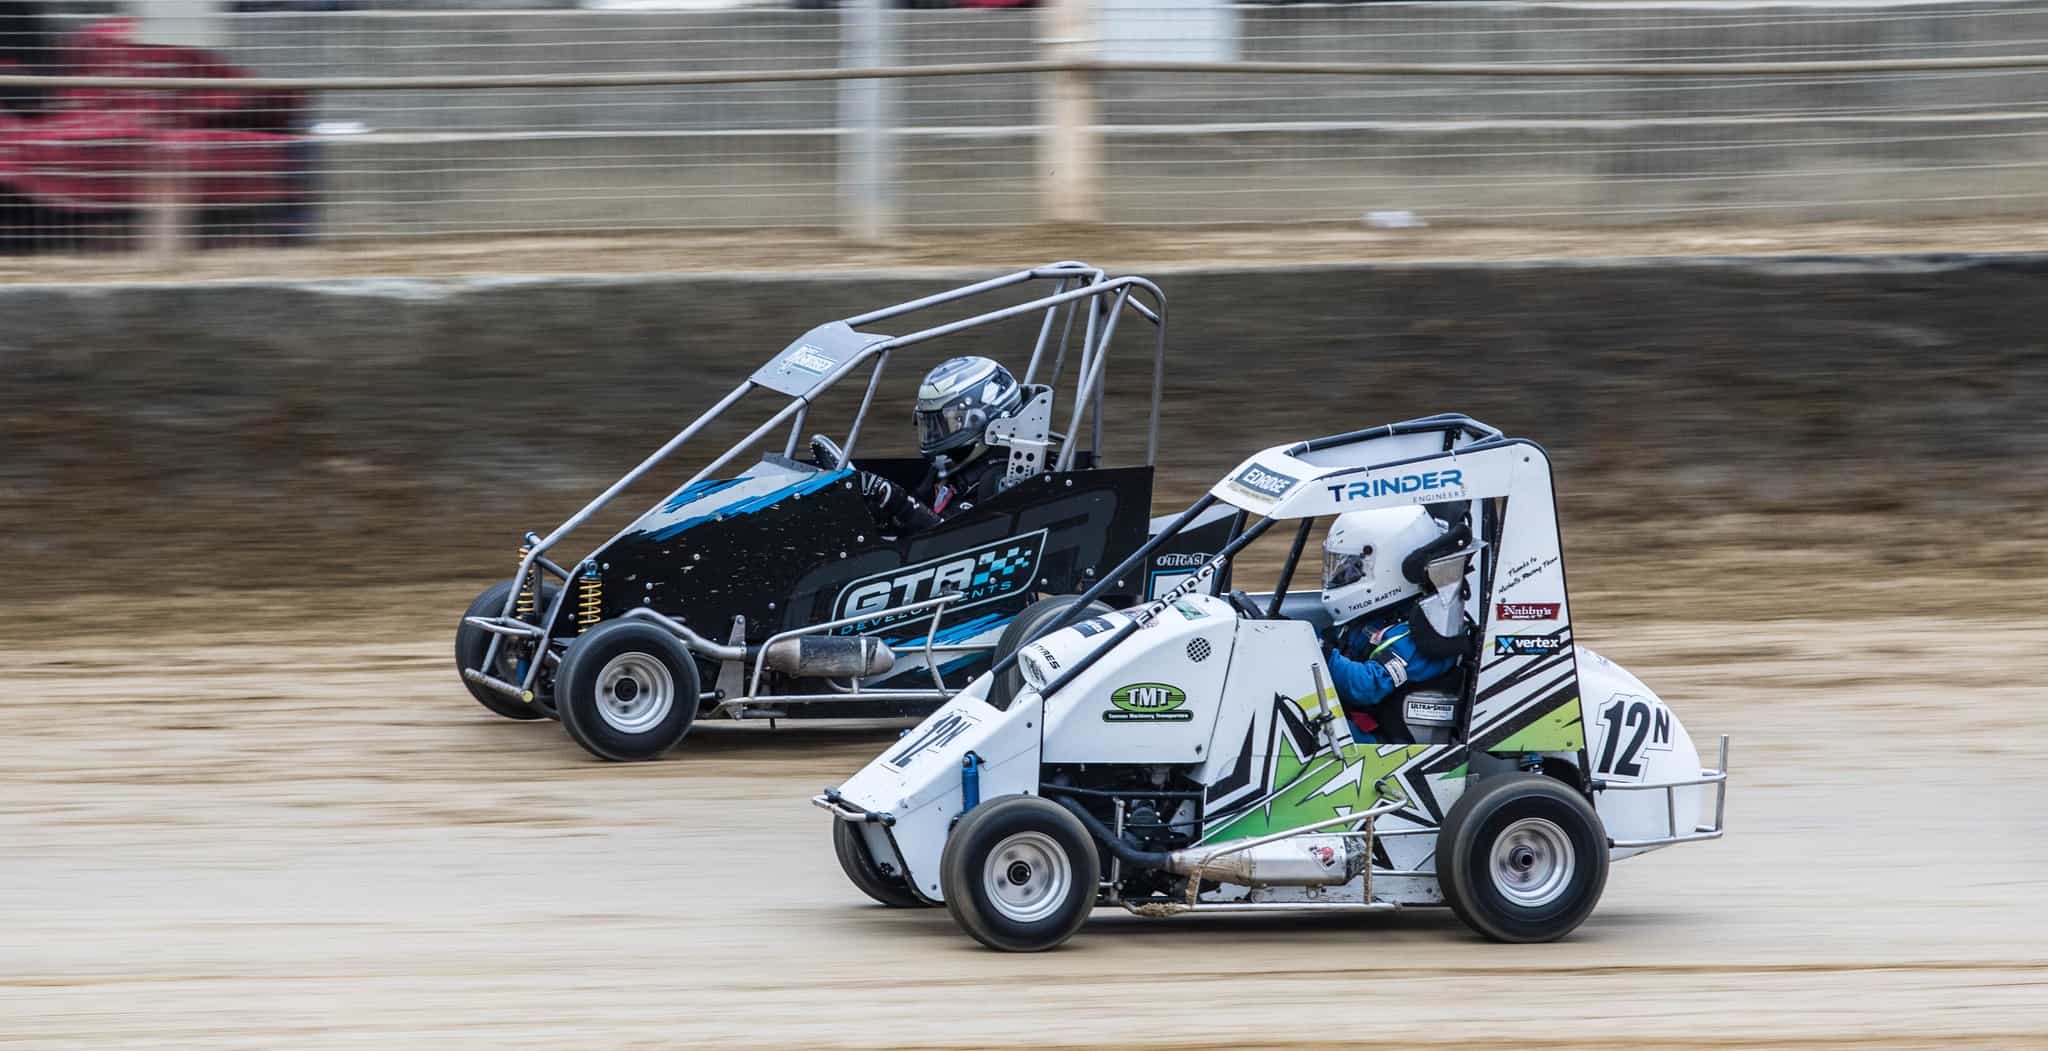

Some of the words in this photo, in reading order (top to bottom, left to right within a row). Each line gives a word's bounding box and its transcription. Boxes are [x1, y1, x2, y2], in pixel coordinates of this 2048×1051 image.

[1327, 469, 1464, 503] TRINDER
[1412, 489, 1467, 503] ENGINEERS
[844, 558, 976, 619] GTR
[1135, 554, 1226, 627] EDRIDGE
[1348, 599, 1373, 612] TAYLOR
[1375, 588, 1402, 603] MARTIN
[841, 580, 1012, 636] DEVELONTS
[1503, 605, 1552, 618] Nabby's
[1515, 637, 1559, 648] vertex
[1127, 687, 1172, 708] TMT
